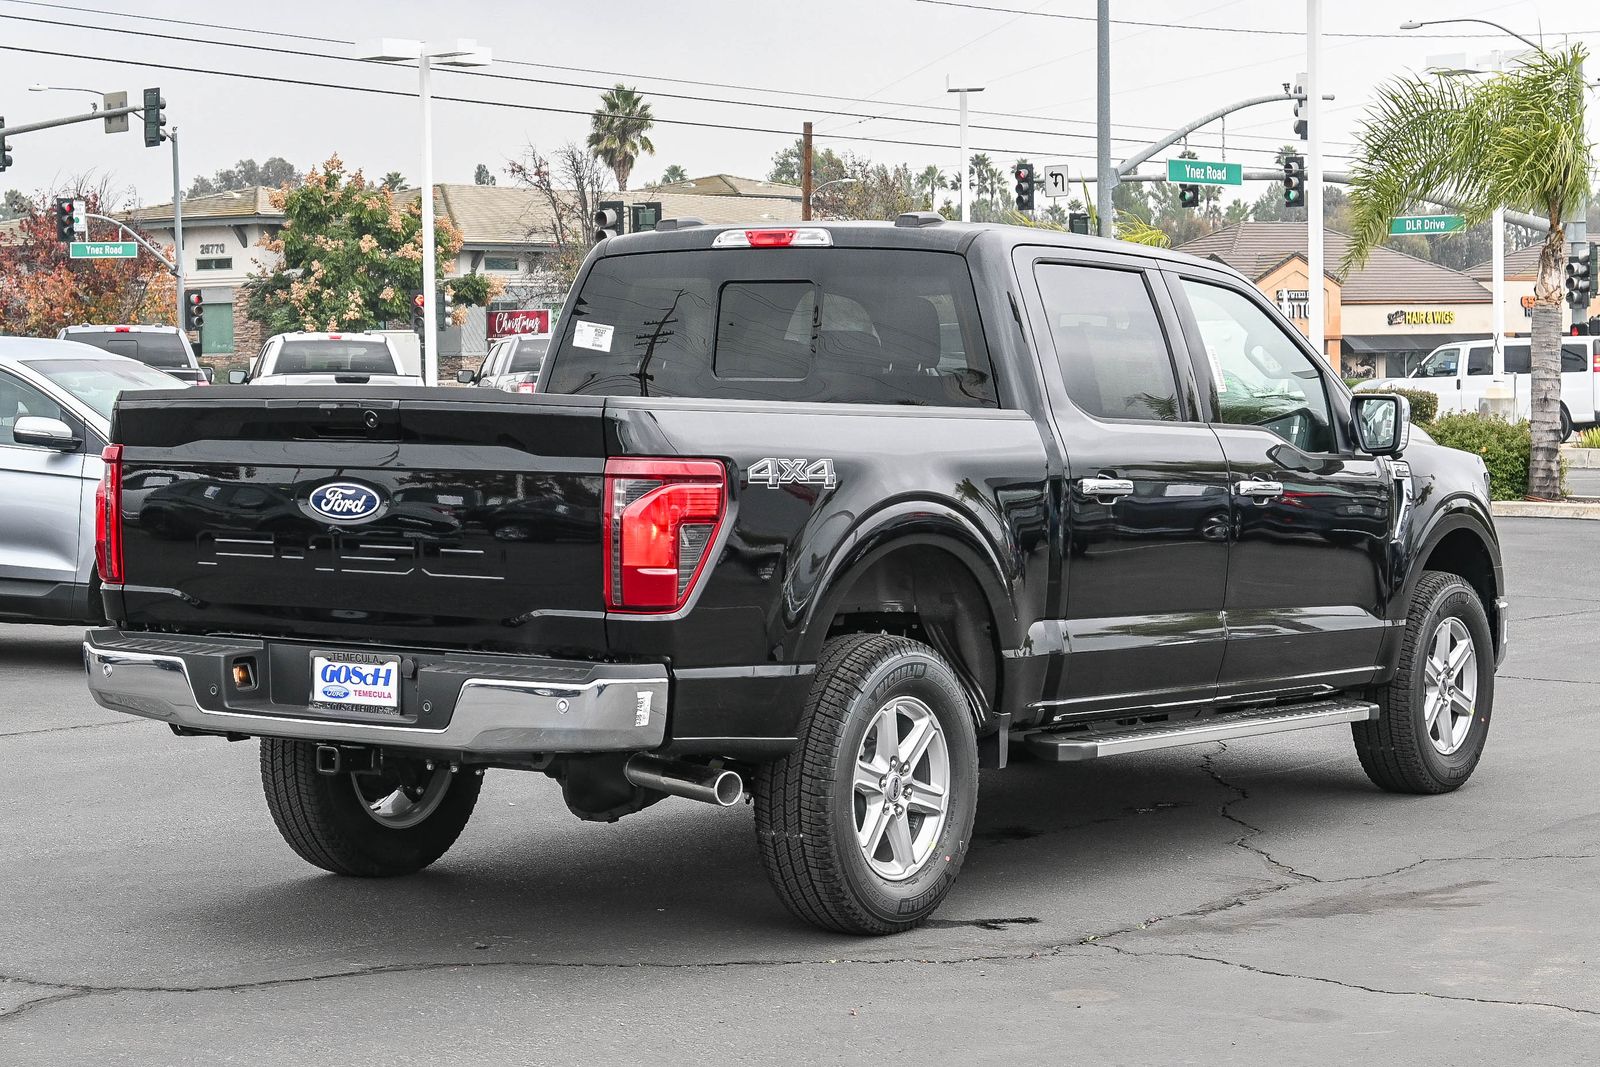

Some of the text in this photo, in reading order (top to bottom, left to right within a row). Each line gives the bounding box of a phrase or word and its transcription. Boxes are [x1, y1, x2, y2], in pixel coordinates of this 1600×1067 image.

[1185, 164, 1227, 180] Ynez Road
[1406, 219, 1446, 231] DLR Drive
[85, 245, 123, 254] Ynez Road
[495, 312, 540, 334] Christmas
[1405, 311, 1424, 324] HAIR
[1425, 311, 1432, 325] &
[1433, 311, 1455, 324] WIGS
[320, 487, 367, 513] Ford
[331, 652, 379, 664] TEMECULA
[353, 689, 392, 699] TEMECULA
